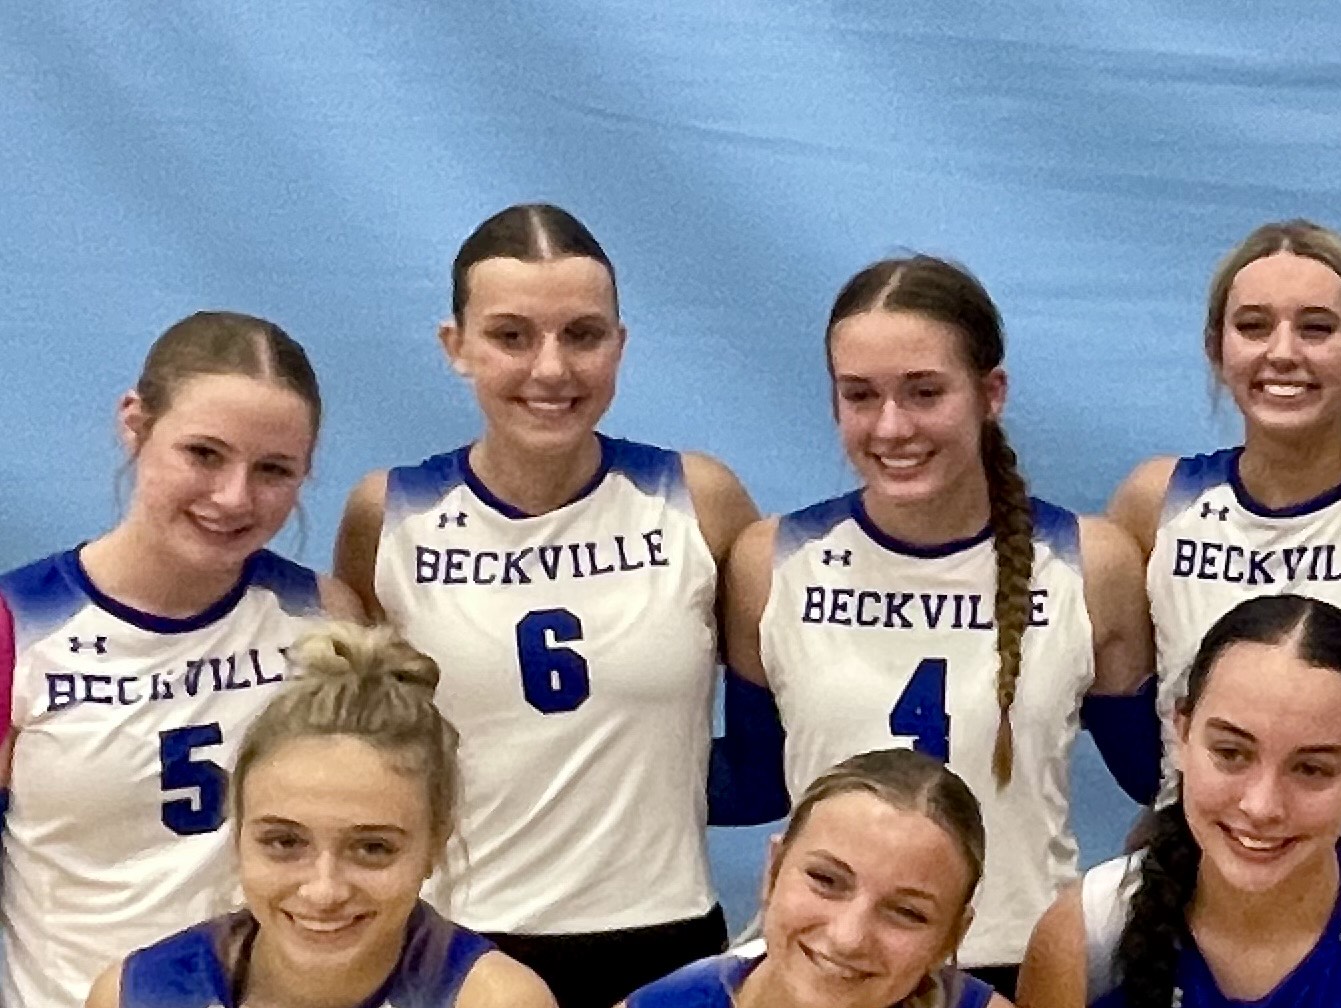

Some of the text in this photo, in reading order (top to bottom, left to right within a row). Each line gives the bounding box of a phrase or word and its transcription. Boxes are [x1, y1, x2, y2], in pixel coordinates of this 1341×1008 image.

[416, 528, 669, 584] BECKVILLE
[802, 586, 1049, 630] BECKVILE
[45, 647, 289, 712] BECKVILL
[516, 607, 590, 715] 6
[888, 658, 951, 764] 4
[159, 721, 230, 836] 5
